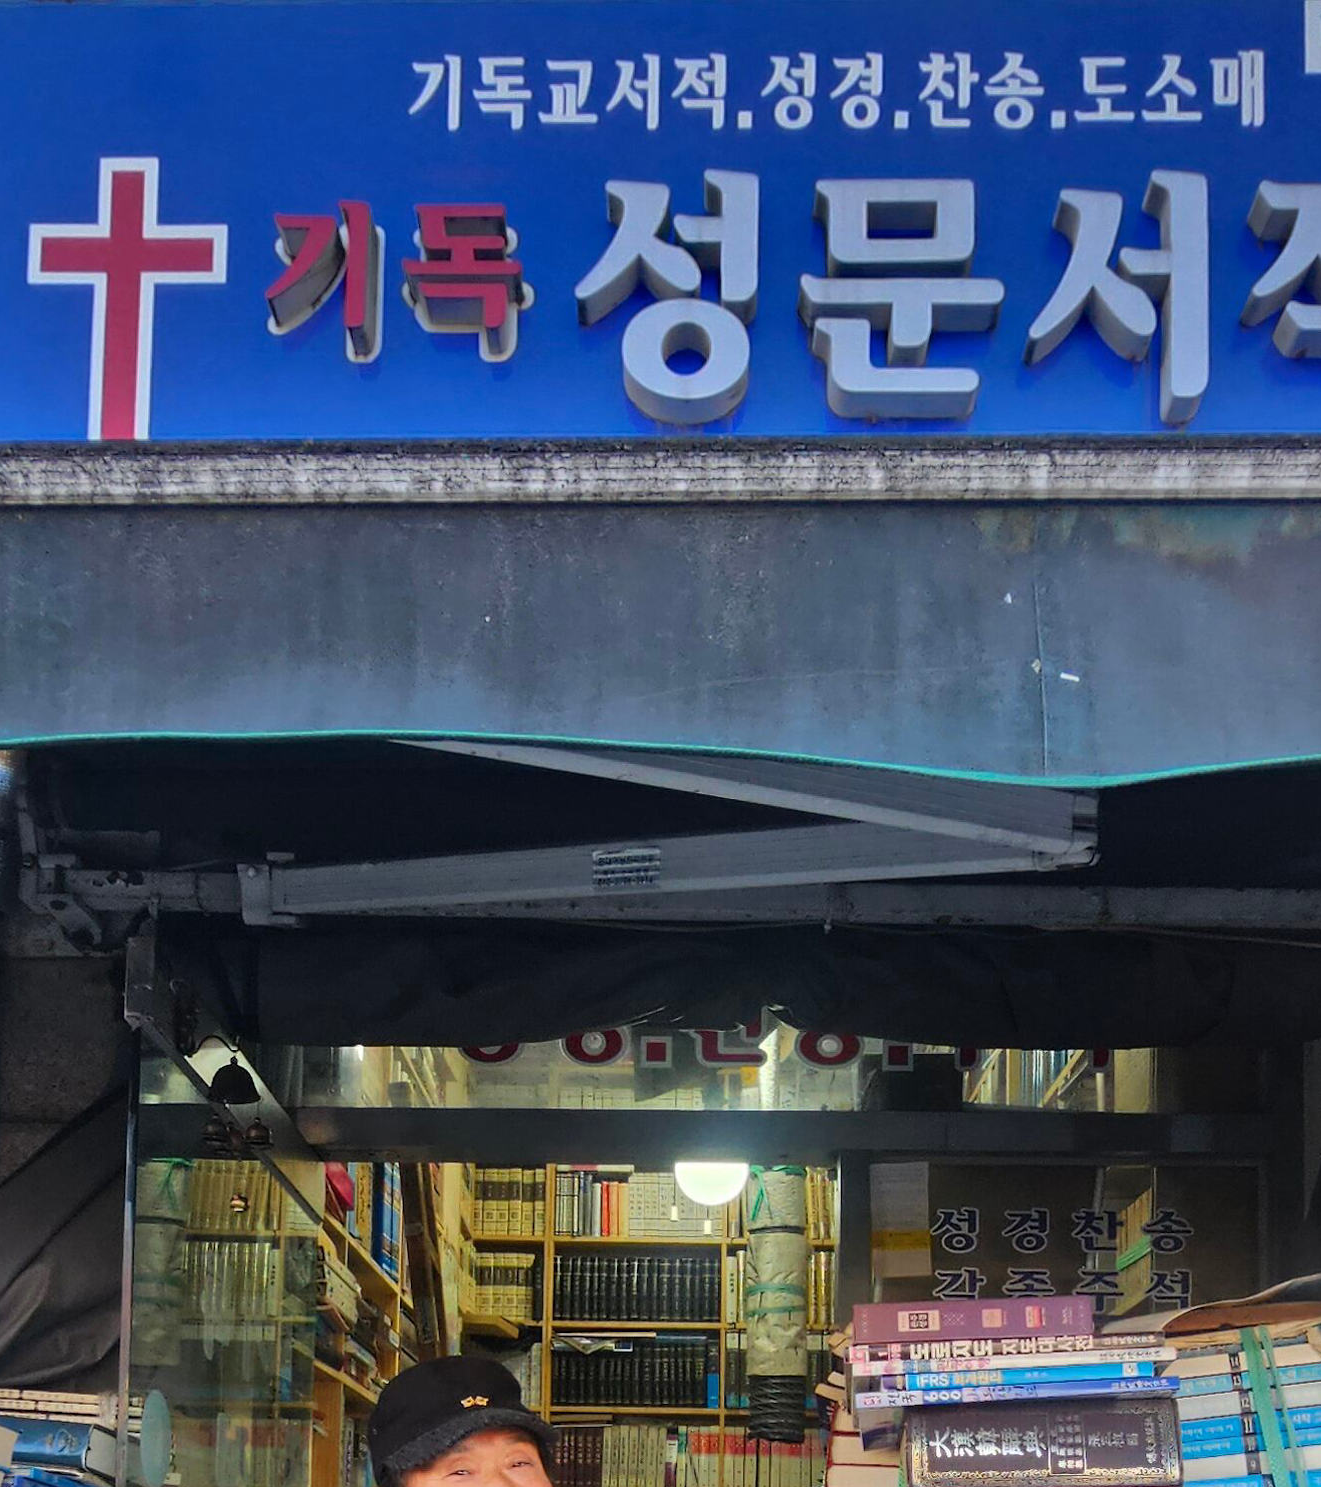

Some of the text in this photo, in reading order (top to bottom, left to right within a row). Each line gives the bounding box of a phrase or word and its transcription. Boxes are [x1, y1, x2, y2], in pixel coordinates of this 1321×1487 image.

[263, 199, 530, 362] 기독
[909, 1338, 993, 1360] 도로지도
[916, 1373, 949, 1387] IFRS
